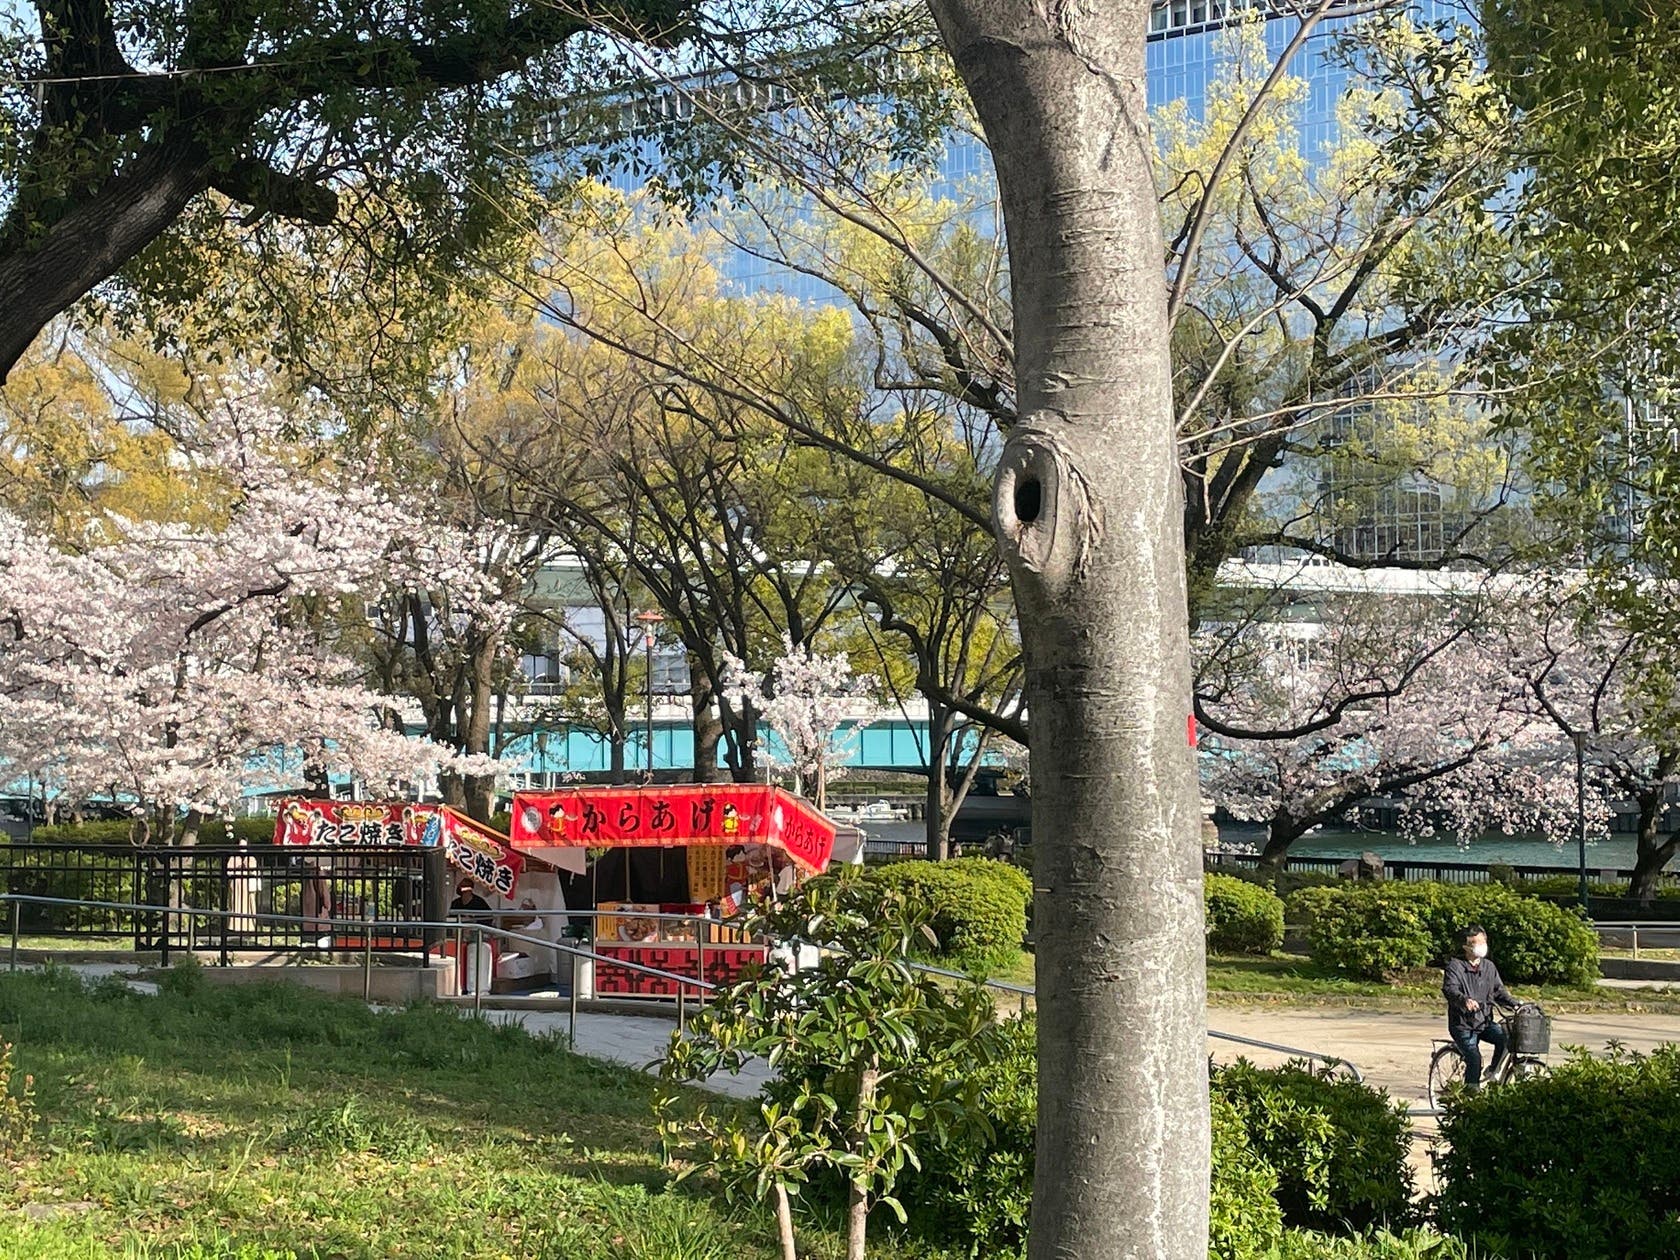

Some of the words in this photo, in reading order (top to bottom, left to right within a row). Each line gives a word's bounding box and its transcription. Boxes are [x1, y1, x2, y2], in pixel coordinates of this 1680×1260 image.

[316, 820, 404, 845] たこ焼き
[582, 799, 715, 834] からあげ
[784, 815, 827, 860] からあげ
